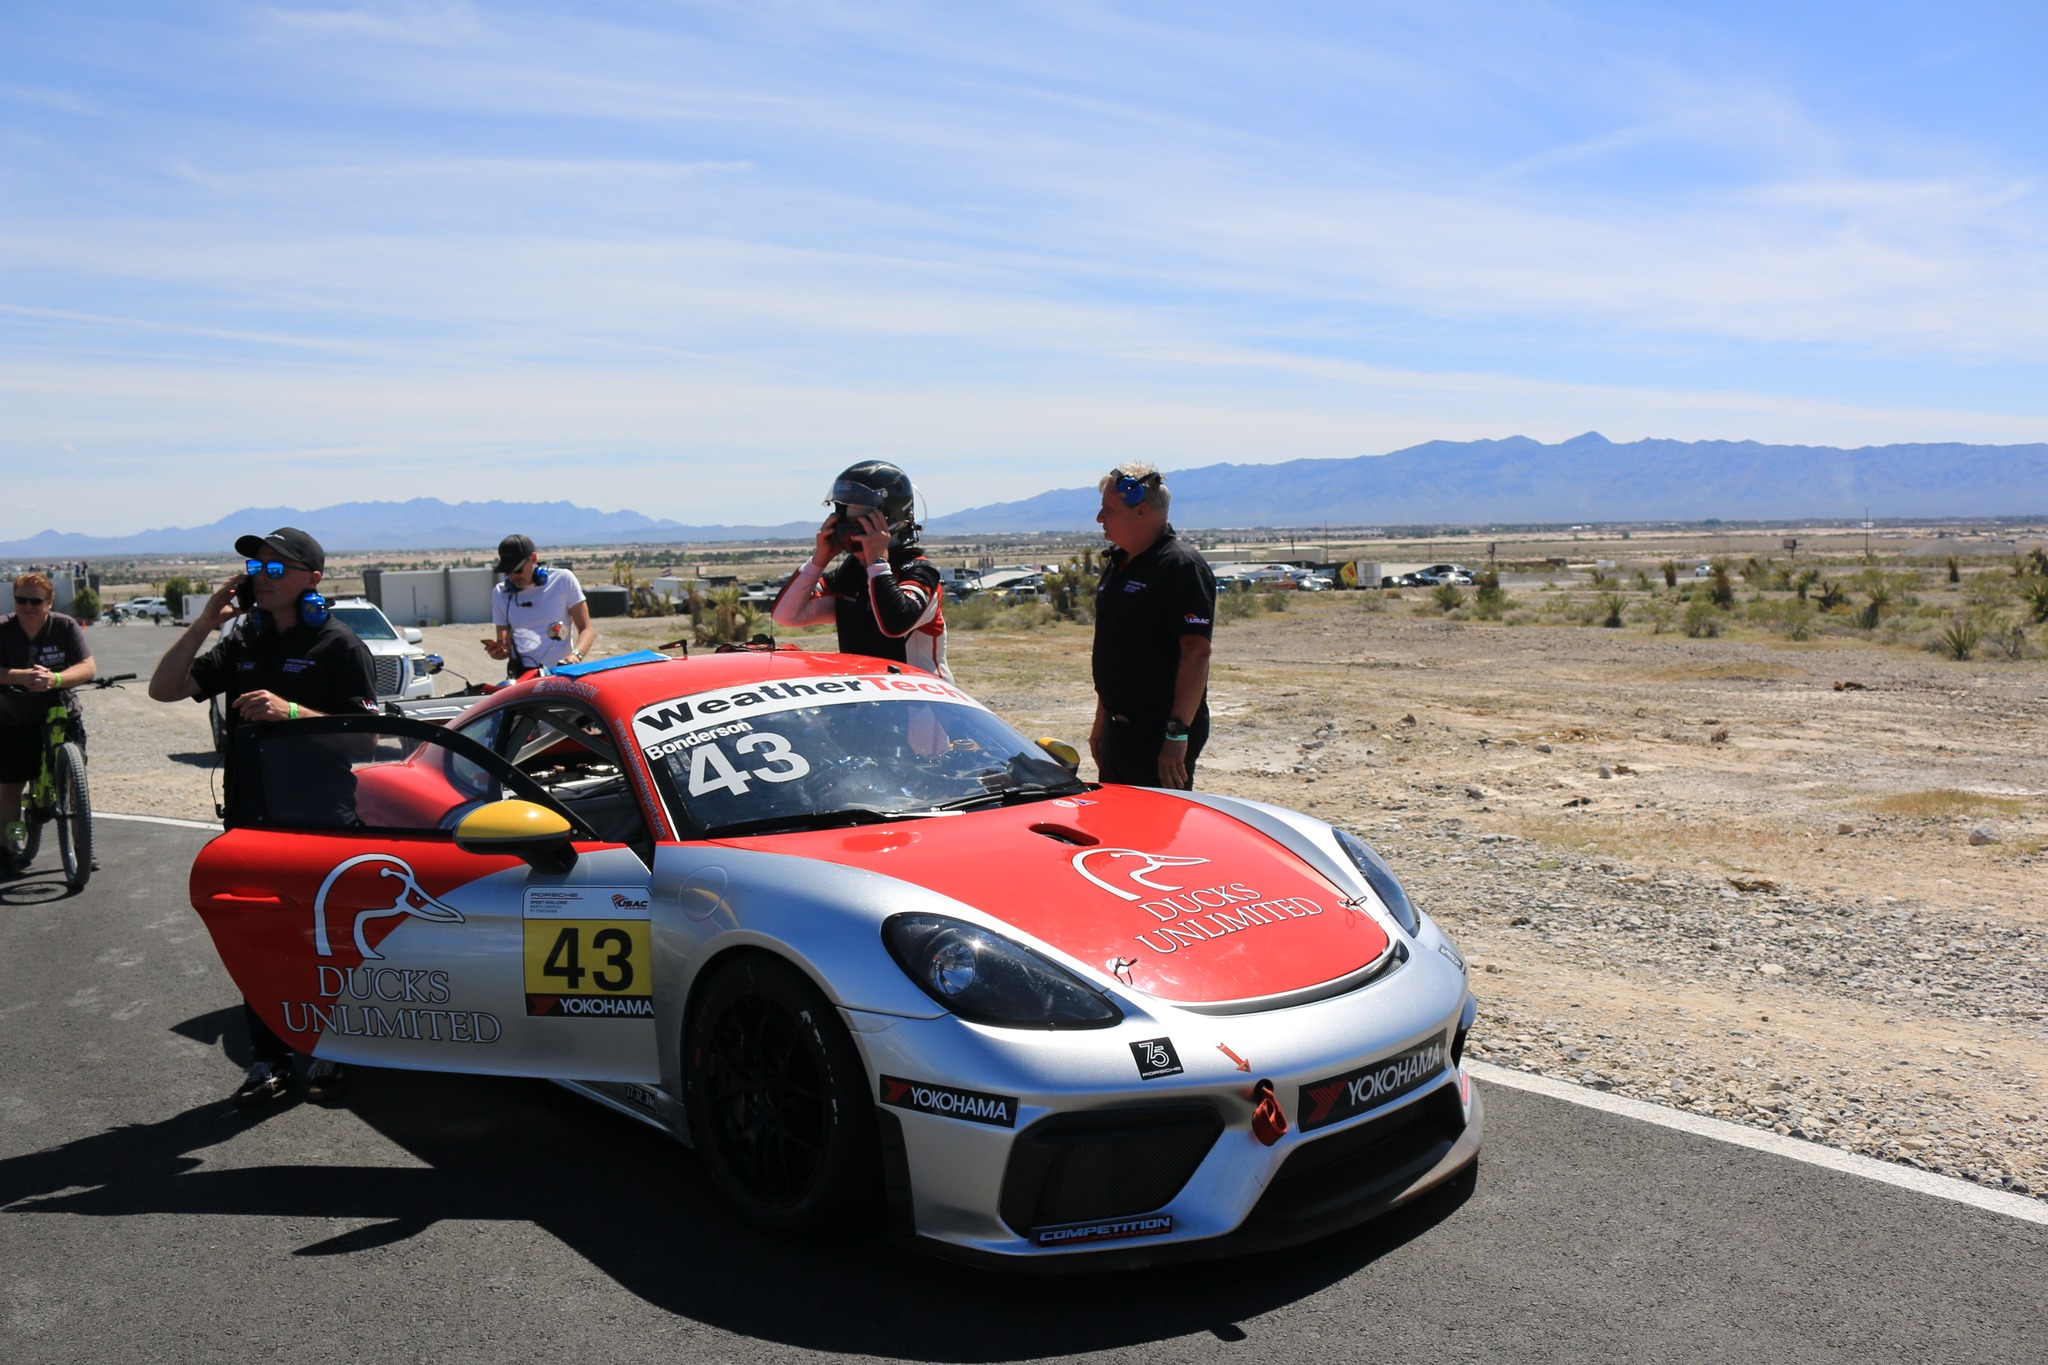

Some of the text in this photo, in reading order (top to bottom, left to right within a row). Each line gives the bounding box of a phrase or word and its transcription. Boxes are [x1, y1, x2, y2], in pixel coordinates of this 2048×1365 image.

[1189, 617, 1210, 625] USAC
[545, 680, 600, 699] BONDERSON
[638, 676, 970, 732] WeatherTech
[644, 721, 753, 761] Bonderson
[614, 717, 666, 838] www.porschemotorsport.com
[687, 732, 811, 797] 43
[1138, 883, 1262, 923] DUCKS
[1134, 897, 1324, 954] UNLIMITED
[543, 927, 634, 992] 43
[316, 965, 450, 1004] DUCKS
[281, 1001, 502, 1044] UNLIMITED
[560, 998, 654, 1015] YOKOHAMA
[1138, 1041, 1170, 1068] 75
[1142, 1066, 1182, 1077] PORSCHE
[1347, 1043, 1441, 1106] YOKOHAMA
[911, 1086, 1008, 1120] YOKOHAMA
[1039, 1217, 1171, 1241] COMPETITION
